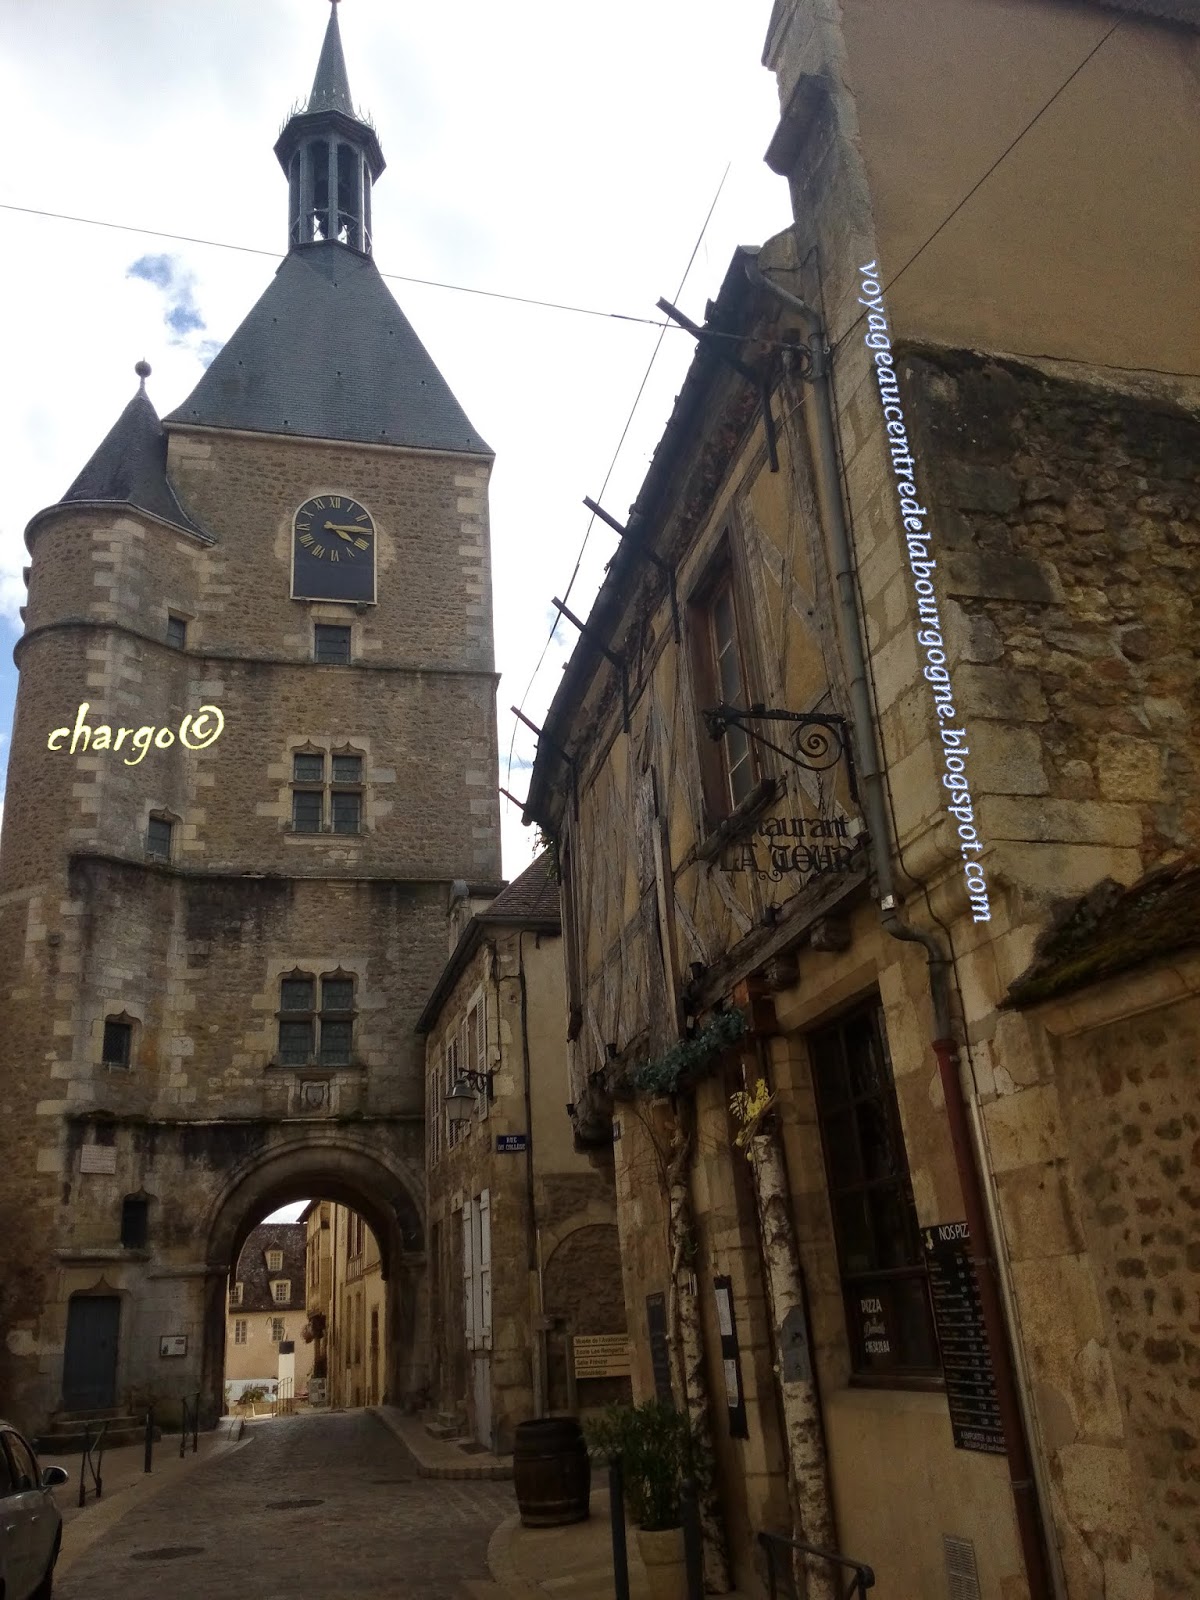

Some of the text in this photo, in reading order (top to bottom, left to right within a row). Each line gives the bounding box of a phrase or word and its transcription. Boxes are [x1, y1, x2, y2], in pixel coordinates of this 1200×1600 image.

[329, 496, 341, 509] XII
[300, 510, 315, 519] X
[757, 814, 850, 838] taurant
[767, 844, 855, 874] TOUR
[939, 1225, 955, 1241] NOS
[860, 1298, 883, 1313] PIZZA
